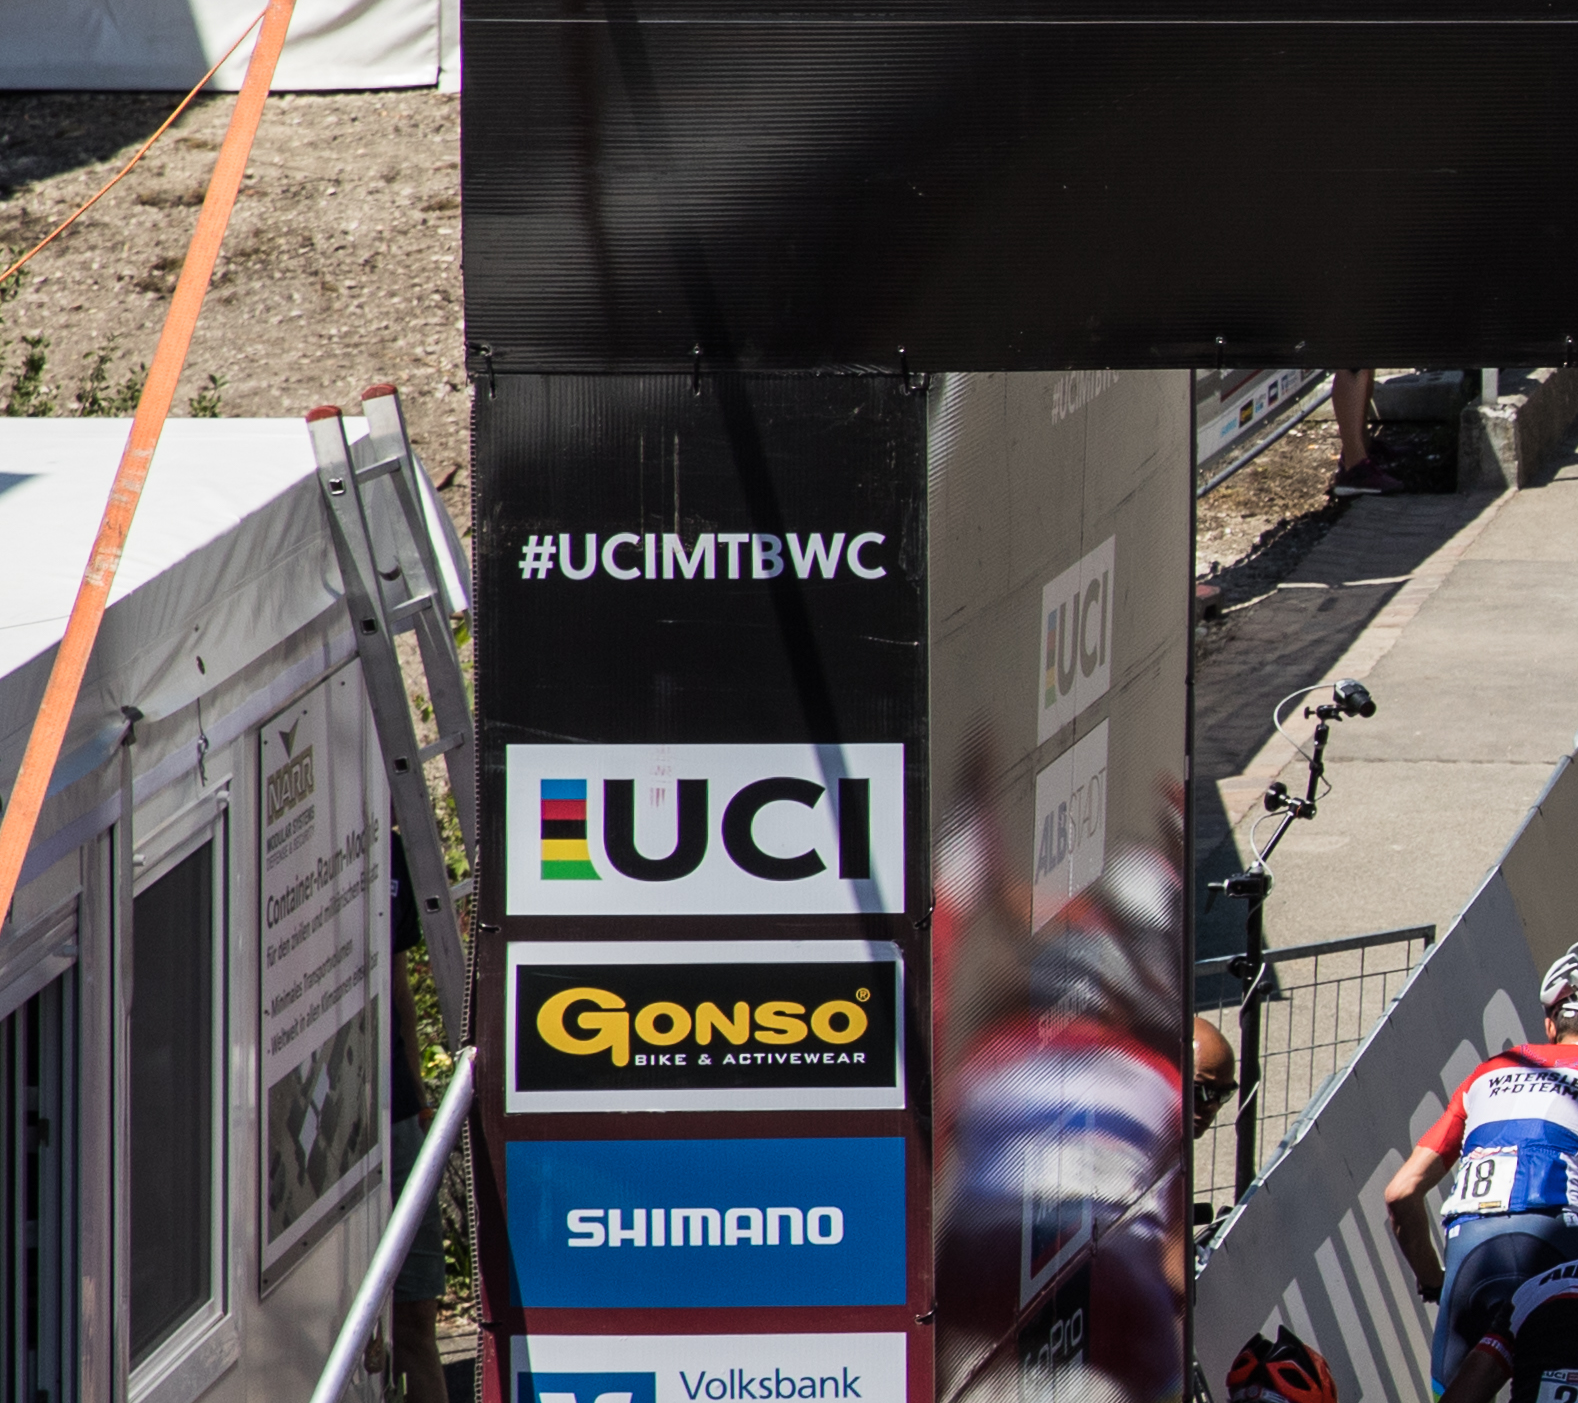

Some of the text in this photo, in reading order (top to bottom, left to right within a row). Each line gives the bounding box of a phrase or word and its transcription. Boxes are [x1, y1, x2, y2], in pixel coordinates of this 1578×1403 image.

[518, 532, 887, 582] #UCIMTBWC
[603, 776, 870, 882] UCI
[536, 986, 868, 1067] GONSO
[634, 1052, 866, 1065] BIKE & ACTIVEWEAR
[567, 1206, 844, 1247] SHIMANO
[679, 1369, 862, 1401] Volksbank
